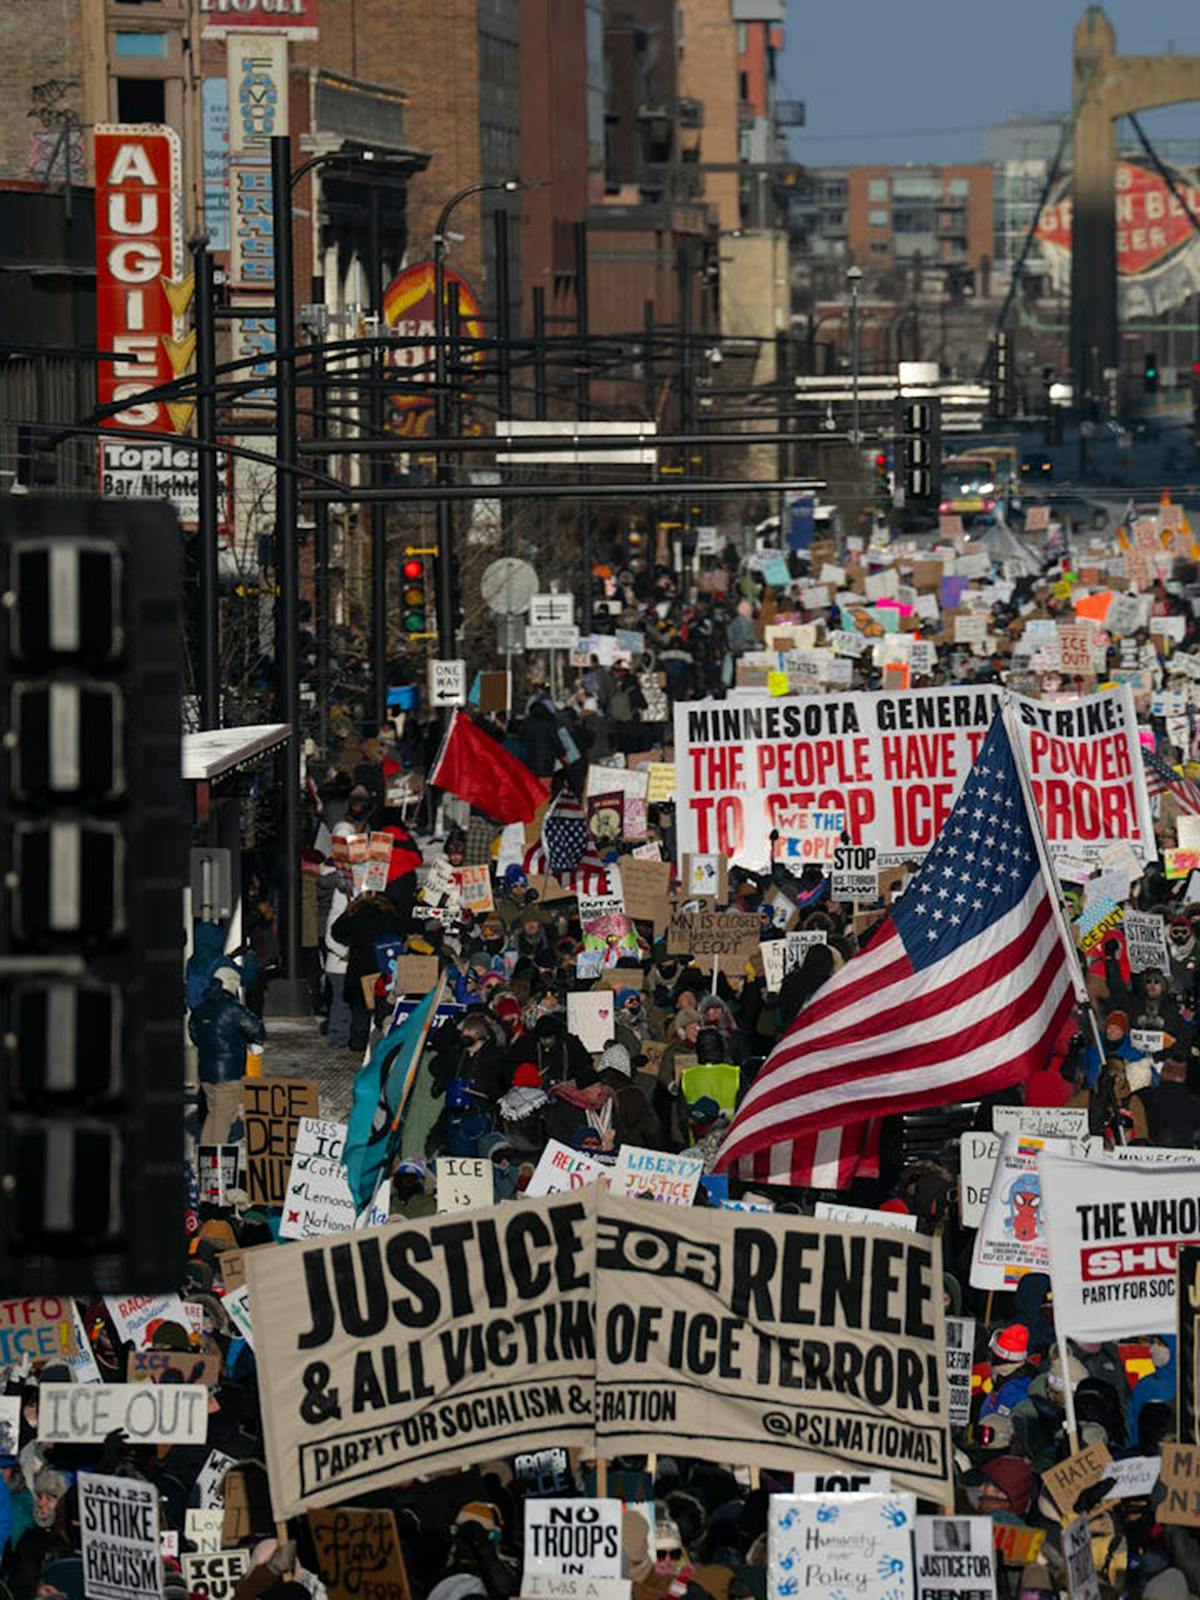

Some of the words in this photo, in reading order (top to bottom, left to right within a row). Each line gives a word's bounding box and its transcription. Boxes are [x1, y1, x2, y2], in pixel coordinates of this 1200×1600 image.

[107, 144, 163, 426] AUGIES
[436, 667, 460, 676] ONE
[437, 678, 462, 688] WAY
[688, 702, 858, 743] MINNESOTA
[1019, 697, 1126, 737] STRIKE:
[688, 746, 745, 791] THE
[757, 737, 870, 788] PEOPLE
[882, 734, 956, 779] HAVE
[1029, 731, 1131, 781] POWER
[690, 798, 746, 859] TO
[893, 784, 953, 848] ICE
[777, 813, 806, 830] WE
[812, 811, 844, 831] THE
[834, 847, 876, 871] STOP
[1127, 925, 1165, 945] STRIKE
[244, 1085, 307, 1119] ICE
[304, 1120, 339, 1136] USES
[446, 1159, 483, 1177] ICE
[626, 1153, 702, 1178] LIBERTY
[625, 1172, 692, 1196] JUSTICE
[1076, 1203, 1128, 1240] THE
[297, 1201, 592, 1350] JUSTICE
[597, 1222, 718, 1292] FOR
[731, 1227, 936, 1341] RENEE
[1082, 1284, 1123, 1306] PARTY
[1123, 1282, 1148, 1300] FOR
[299, 1360, 342, 1425] &
[353, 1339, 435, 1413] ALL
[438, 1300, 596, 1387] VICTIM
[606, 1303, 663, 1365] OF
[668, 1309, 746, 1379] ICE
[752, 1325, 941, 1413] TERROR!
[45, 1389, 113, 1438] ICE
[124, 1390, 205, 1436] OUT
[313, 1430, 388, 1482] PARTY
[384, 1408, 439, 1455] FOR
[441, 1385, 565, 1438] SOCIALISM
[567, 1385, 593, 1414] &
[762, 1411, 938, 1465] @PSLNATIONAL
[1054, 1453, 1103, 1490] HATE
[83, 1483, 153, 1503] JAN.23
[84, 1496, 155, 1543] STRIKE
[548, 1506, 600, 1524] NO
[314, 1516, 394, 1592] Fight
[529, 1524, 619, 1559] TROOPS
[804, 1527, 881, 1559] Humanity
[87, 1547, 159, 1592] RACISM
[190, 1556, 243, 1579] ICE
[561, 1563, 585, 1576] IN
[804, 1565, 876, 1595] Policy
[919, 1555, 964, 1579] JUSTICE
[966, 1555, 992, 1577] FOR
